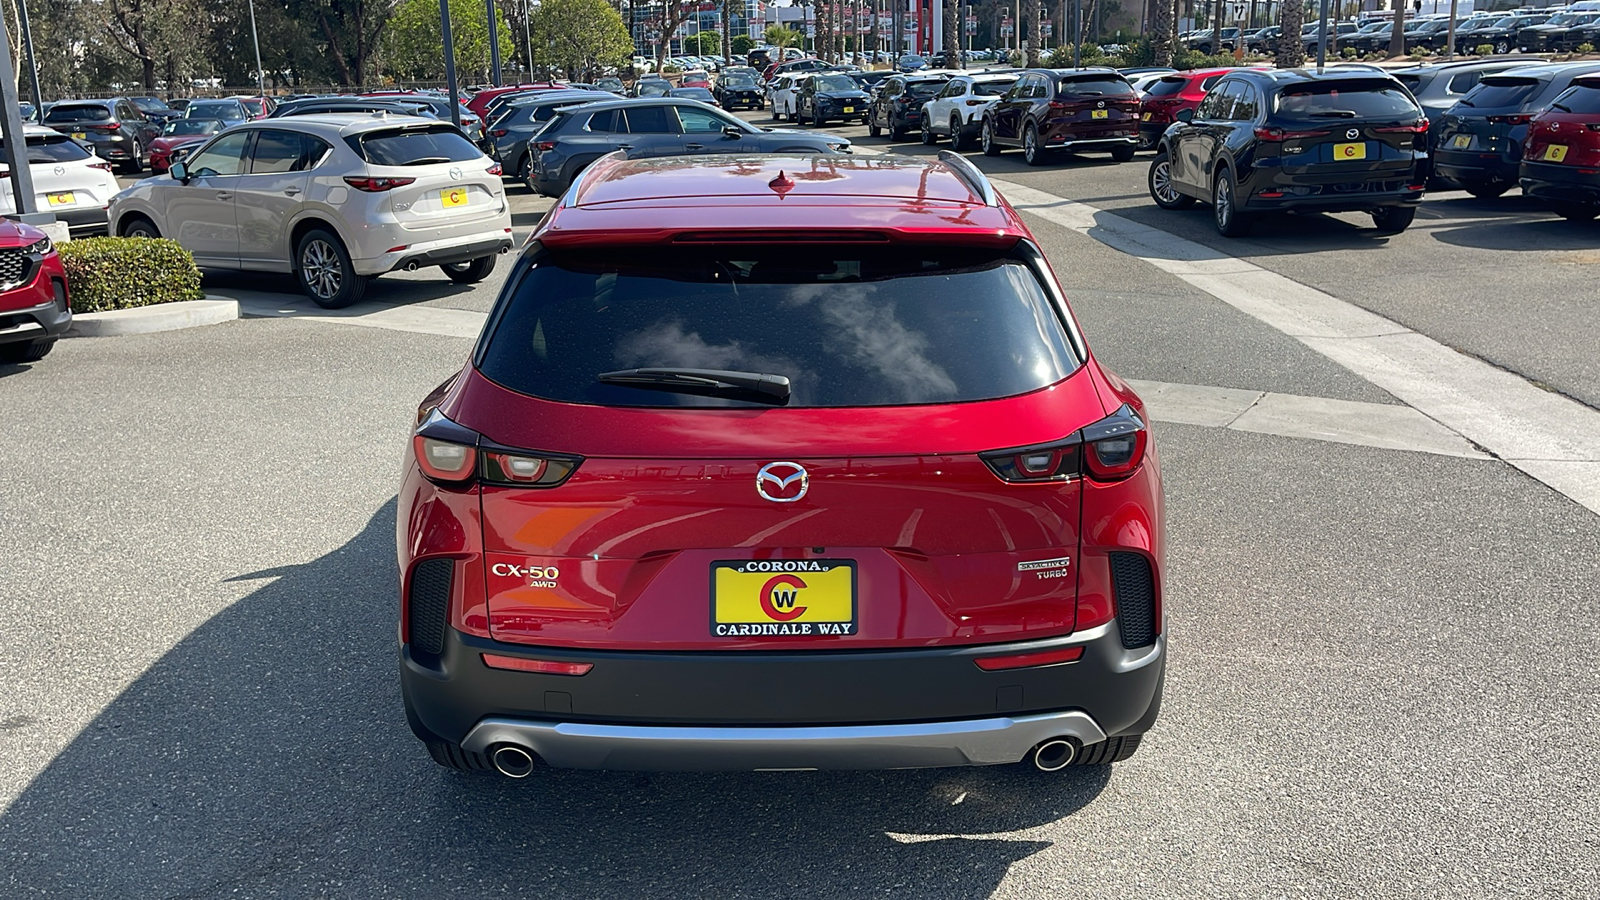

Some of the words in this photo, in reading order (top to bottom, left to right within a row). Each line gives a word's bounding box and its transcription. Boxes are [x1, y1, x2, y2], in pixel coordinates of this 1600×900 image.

[681, 3, 715, 12] NIAN
[491, 563, 560, 580] CX-50
[746, 560, 822, 572] CORONA
[1036, 569, 1068, 580] TURBO
[530, 580, 557, 589] AWD
[715, 622, 812, 636] CARDINALE
[817, 622, 852, 635] WAY
